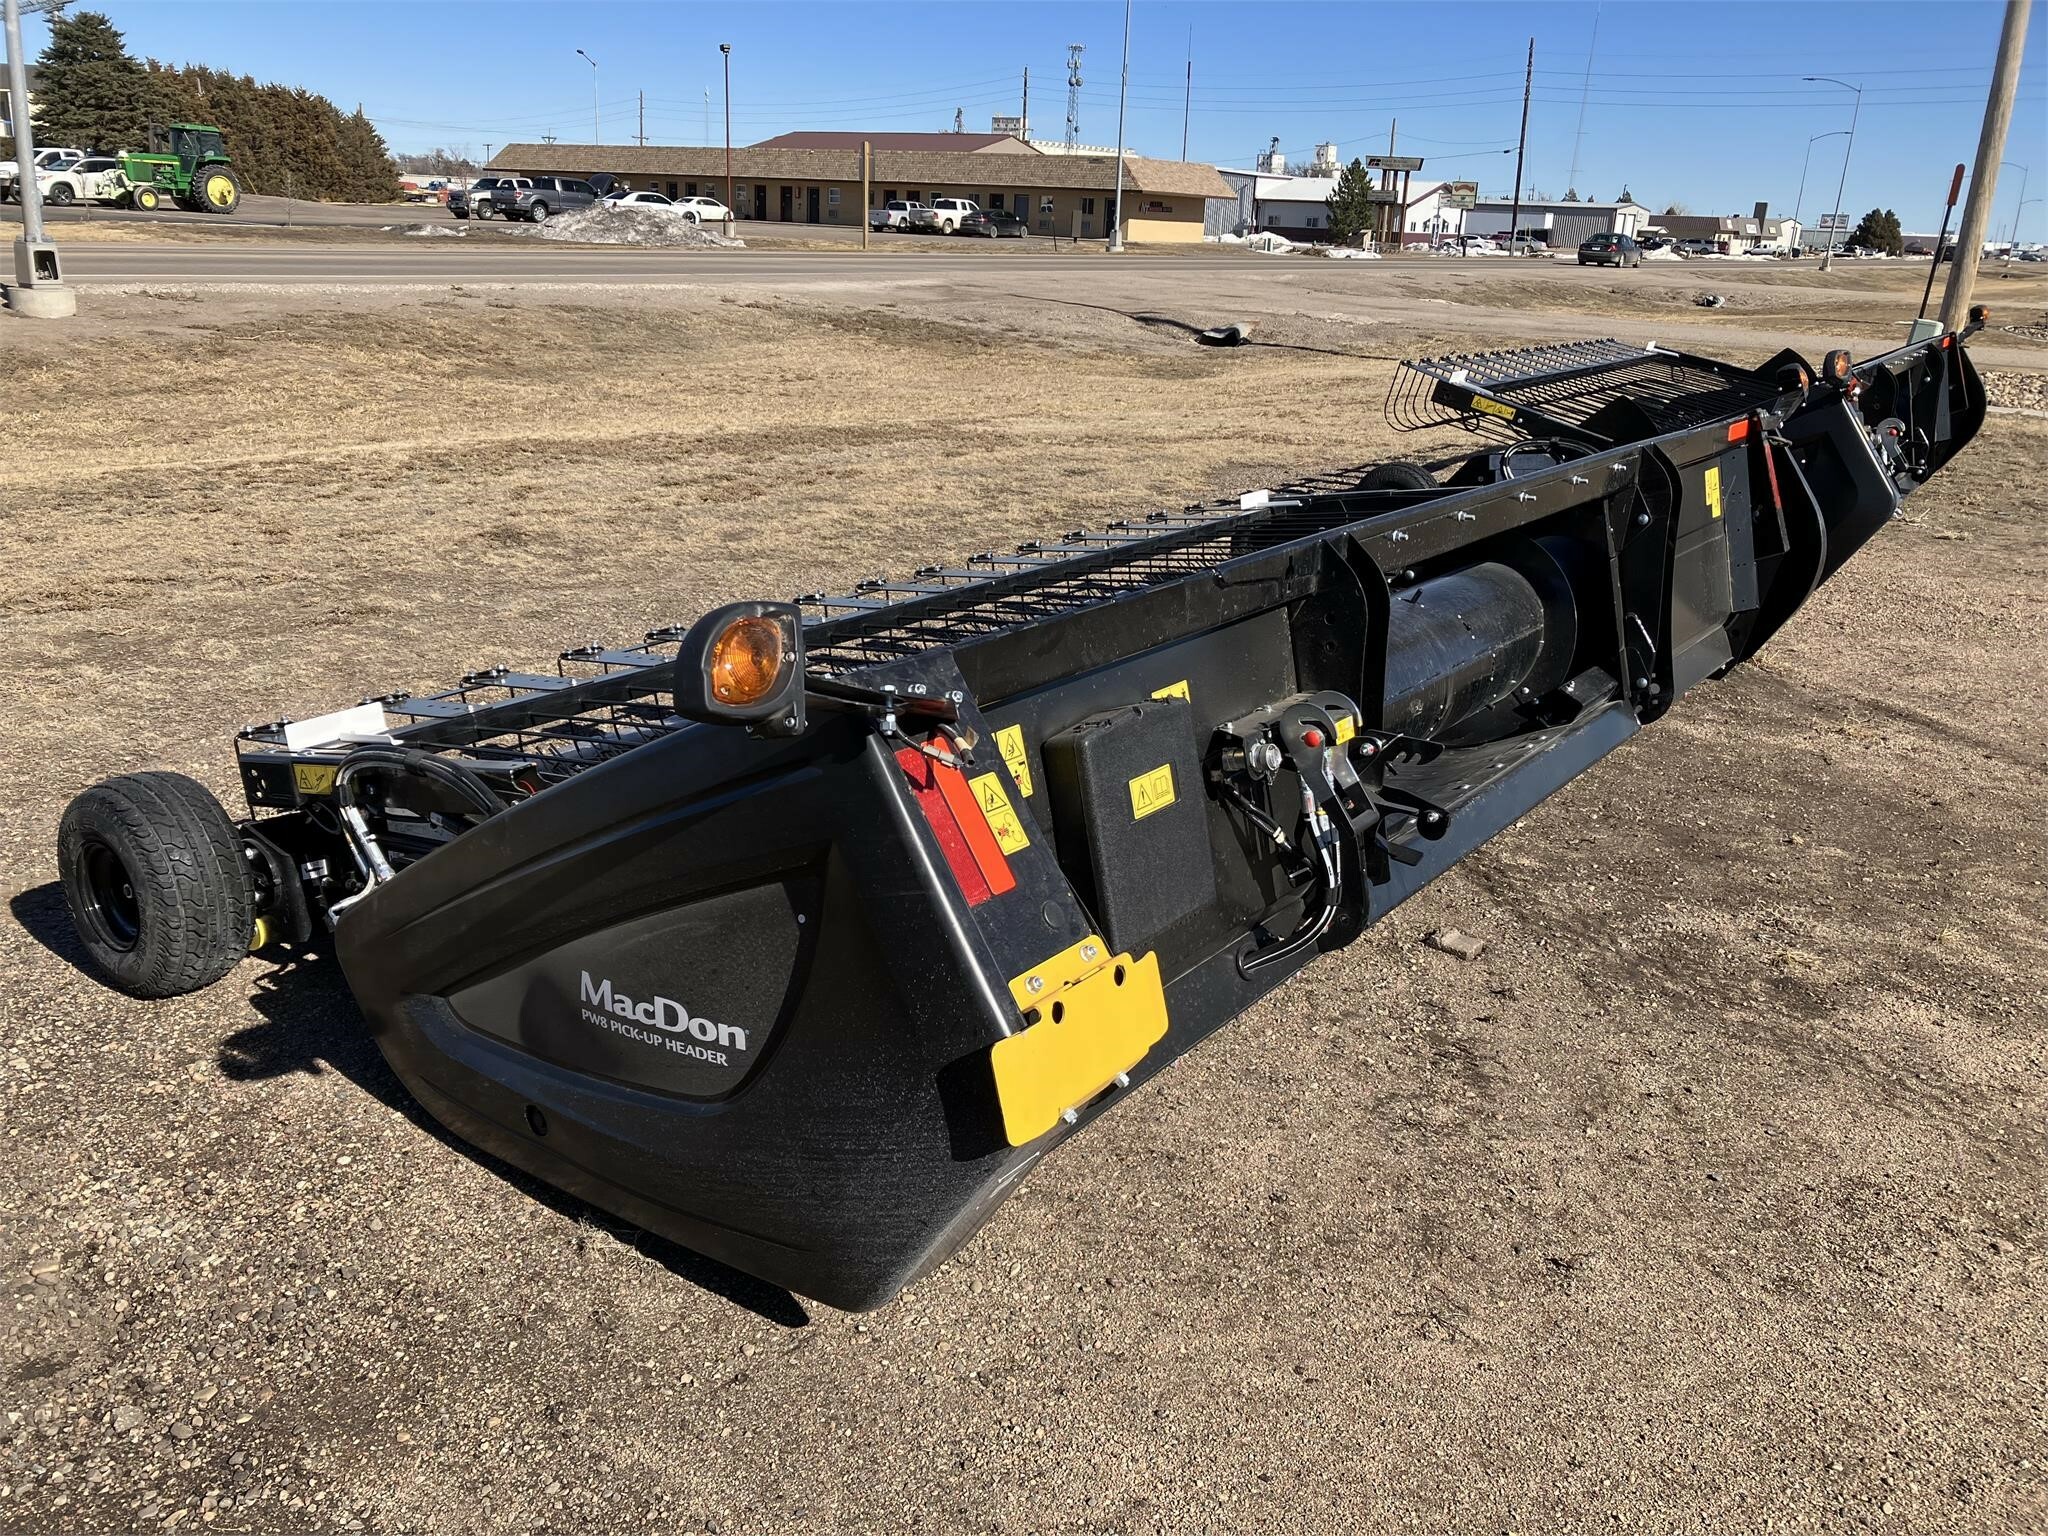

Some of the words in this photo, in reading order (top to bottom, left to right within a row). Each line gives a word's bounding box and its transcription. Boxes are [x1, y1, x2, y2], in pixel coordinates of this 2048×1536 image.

[580, 970, 747, 1051] MacDon
[582, 1008, 608, 1029] PW8
[610, 1020, 663, 1047] PICK-UP
[665, 1038, 728, 1067] HEADER
